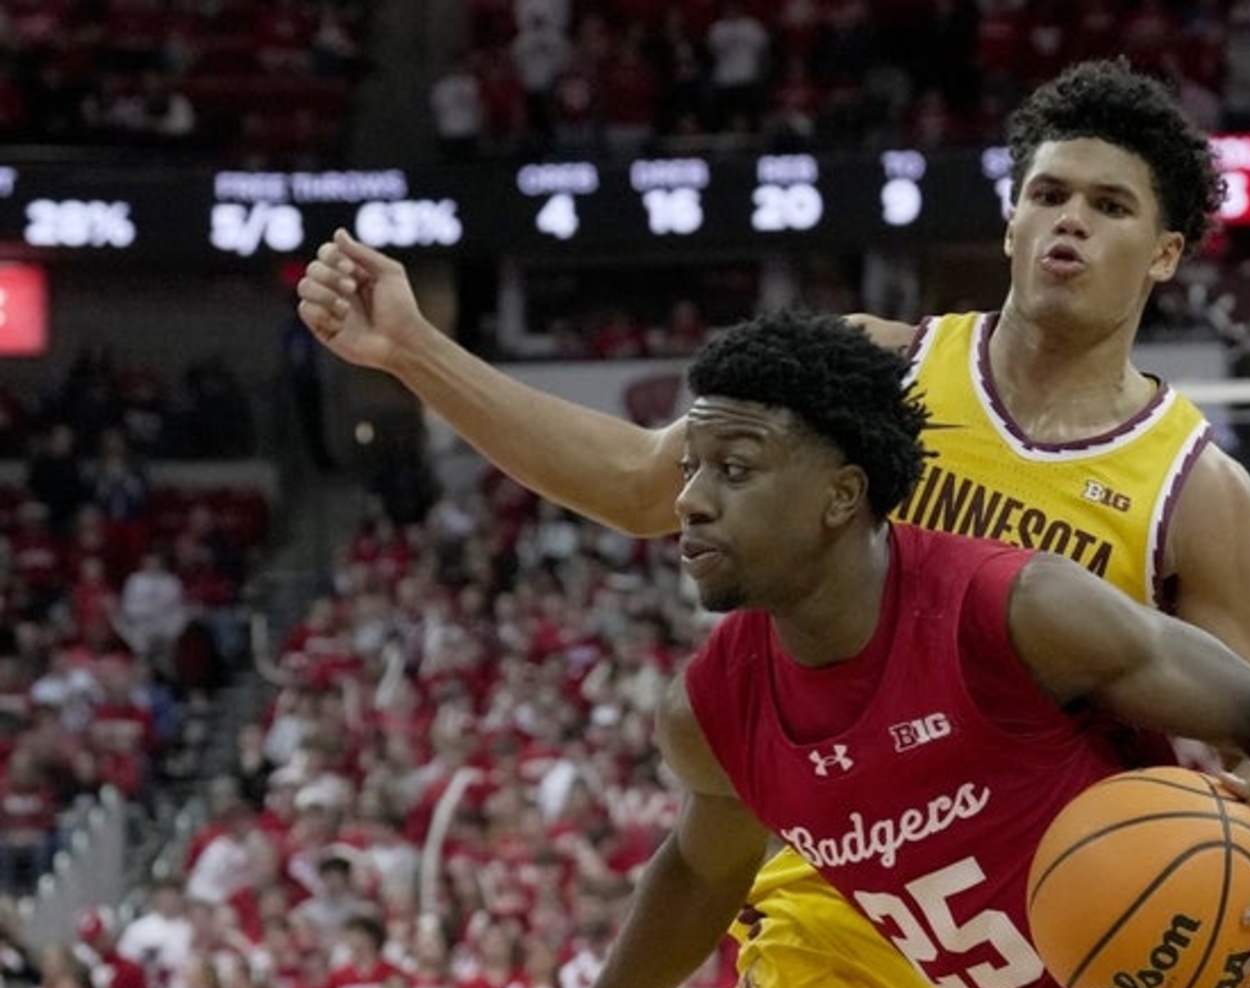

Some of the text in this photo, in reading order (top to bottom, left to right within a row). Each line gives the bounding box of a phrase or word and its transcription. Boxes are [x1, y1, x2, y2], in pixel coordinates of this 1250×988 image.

[535, 193, 579, 240] 4
[898, 465, 1114, 578] INNESOTA
[781, 782, 991, 869] Badgers
